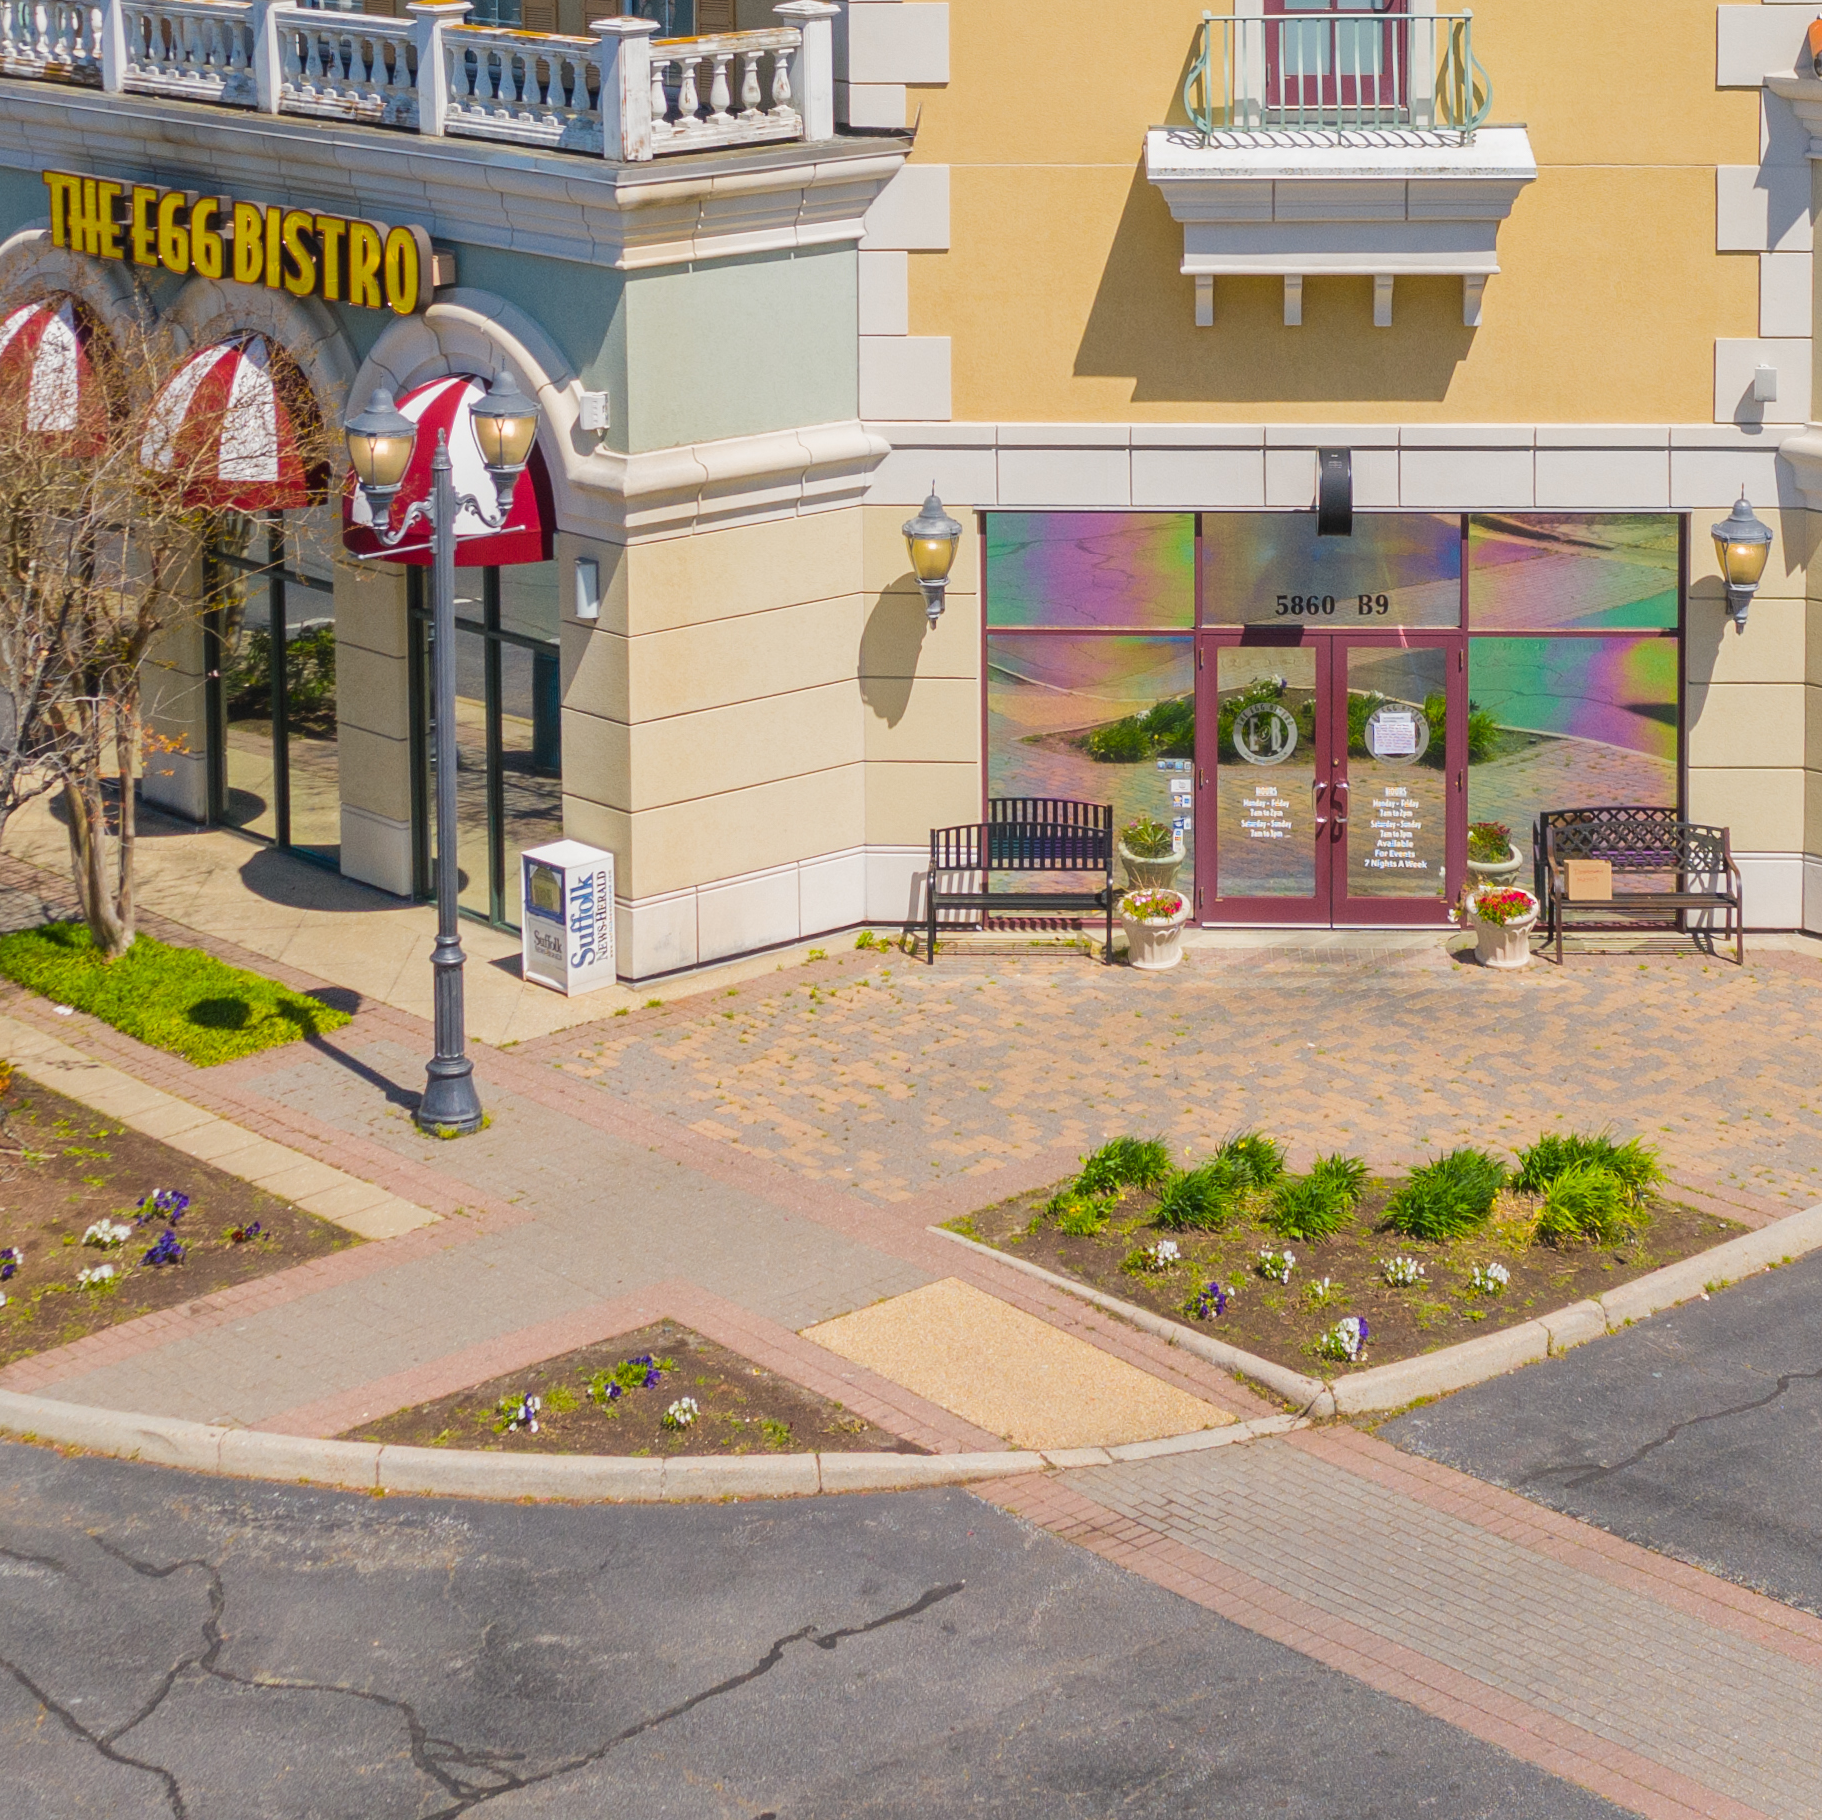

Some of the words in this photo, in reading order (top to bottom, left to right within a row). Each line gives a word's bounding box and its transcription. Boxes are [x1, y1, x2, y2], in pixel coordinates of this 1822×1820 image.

[42, 170, 125, 261] THE
[131, 183, 224, 280] EGG
[233, 200, 420, 316] BISTRO
[1275, 595, 1335, 615] 5860
[1358, 594, 1389, 615] B9
[1250, 704, 1265, 714] EGG
[1374, 849, 1388, 857] For
[1389, 849, 1416, 858] Events
[1377, 839, 1414, 848] Available
[1371, 859, 1397, 869] Nights
[1398, 860, 1404, 868] A
[1405, 860, 1427, 868] Week
[570, 872, 595, 968] Suffolk
[595, 870, 608, 962] NEWS-HERALD
[534, 930, 563, 953] Suffolk
